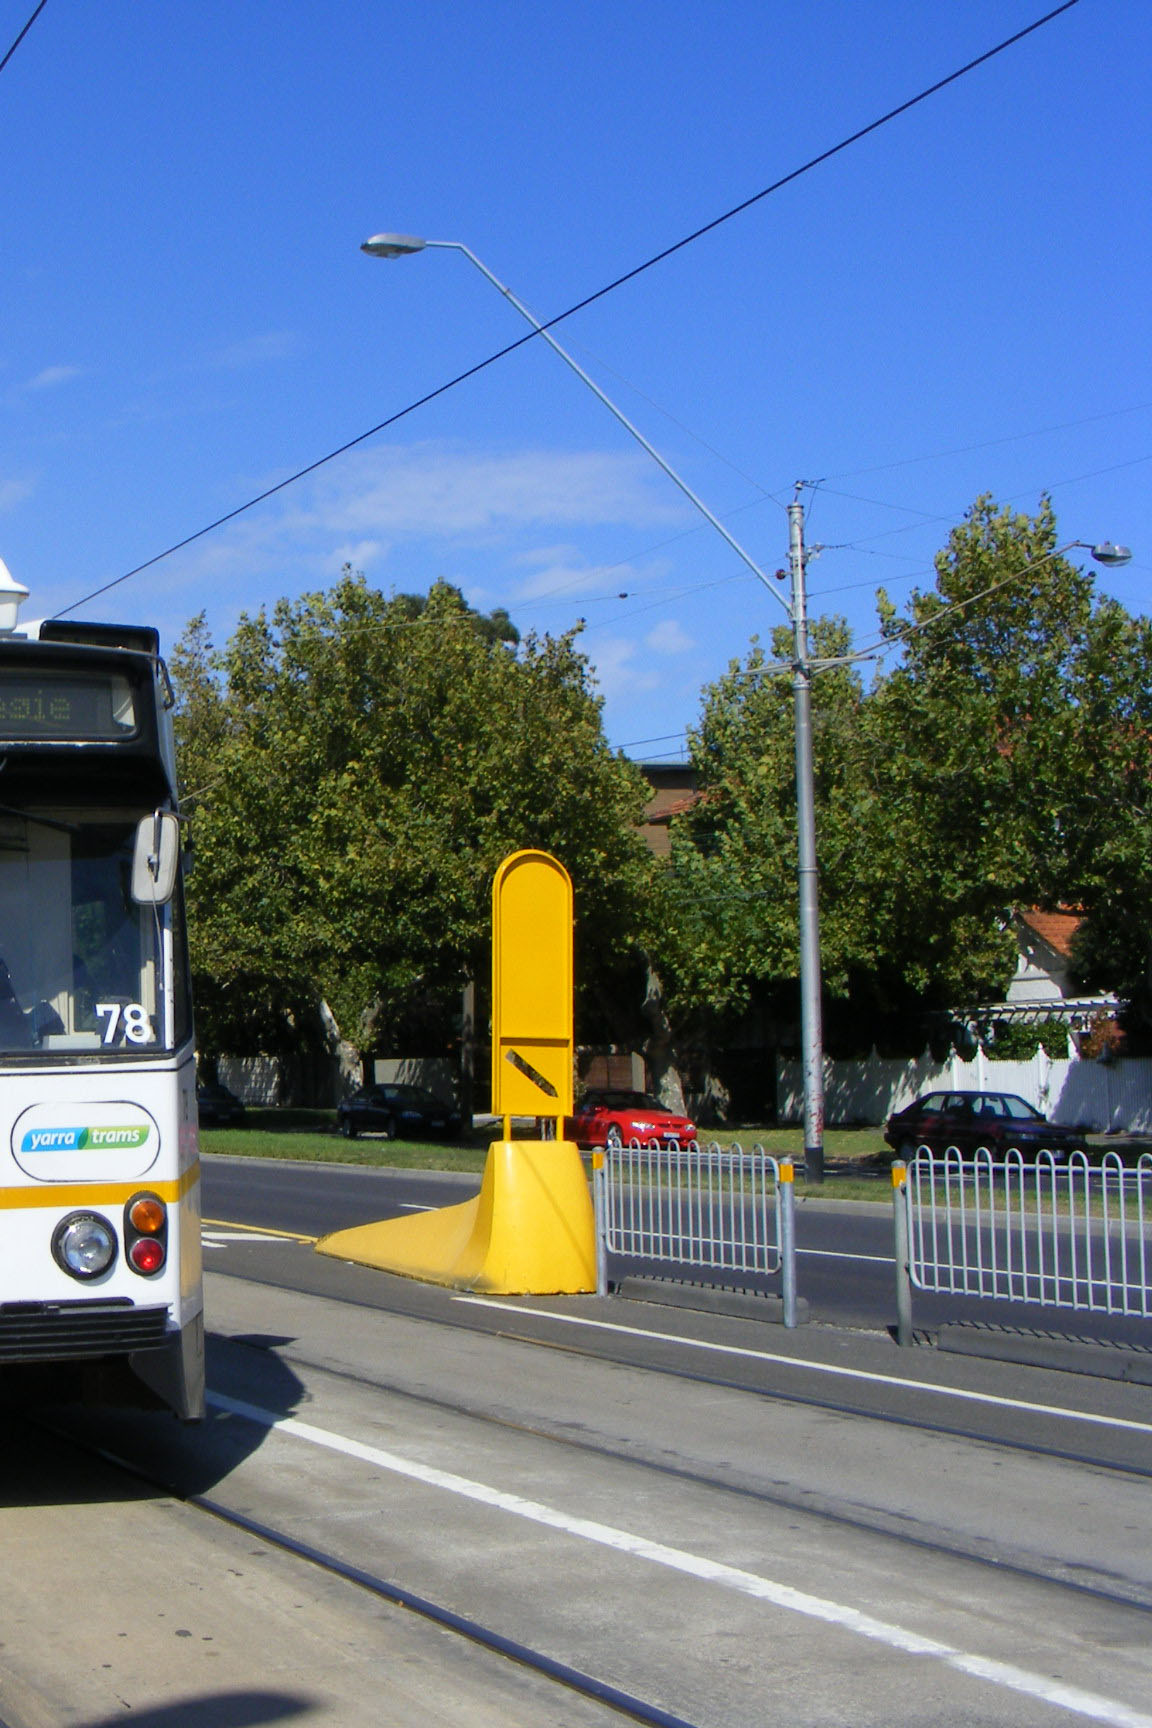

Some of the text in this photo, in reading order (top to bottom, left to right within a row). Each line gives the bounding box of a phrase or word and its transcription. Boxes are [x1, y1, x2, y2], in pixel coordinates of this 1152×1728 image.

[95, 1003, 150, 1043] 78
[31, 1127, 140, 1150] yarra trams
